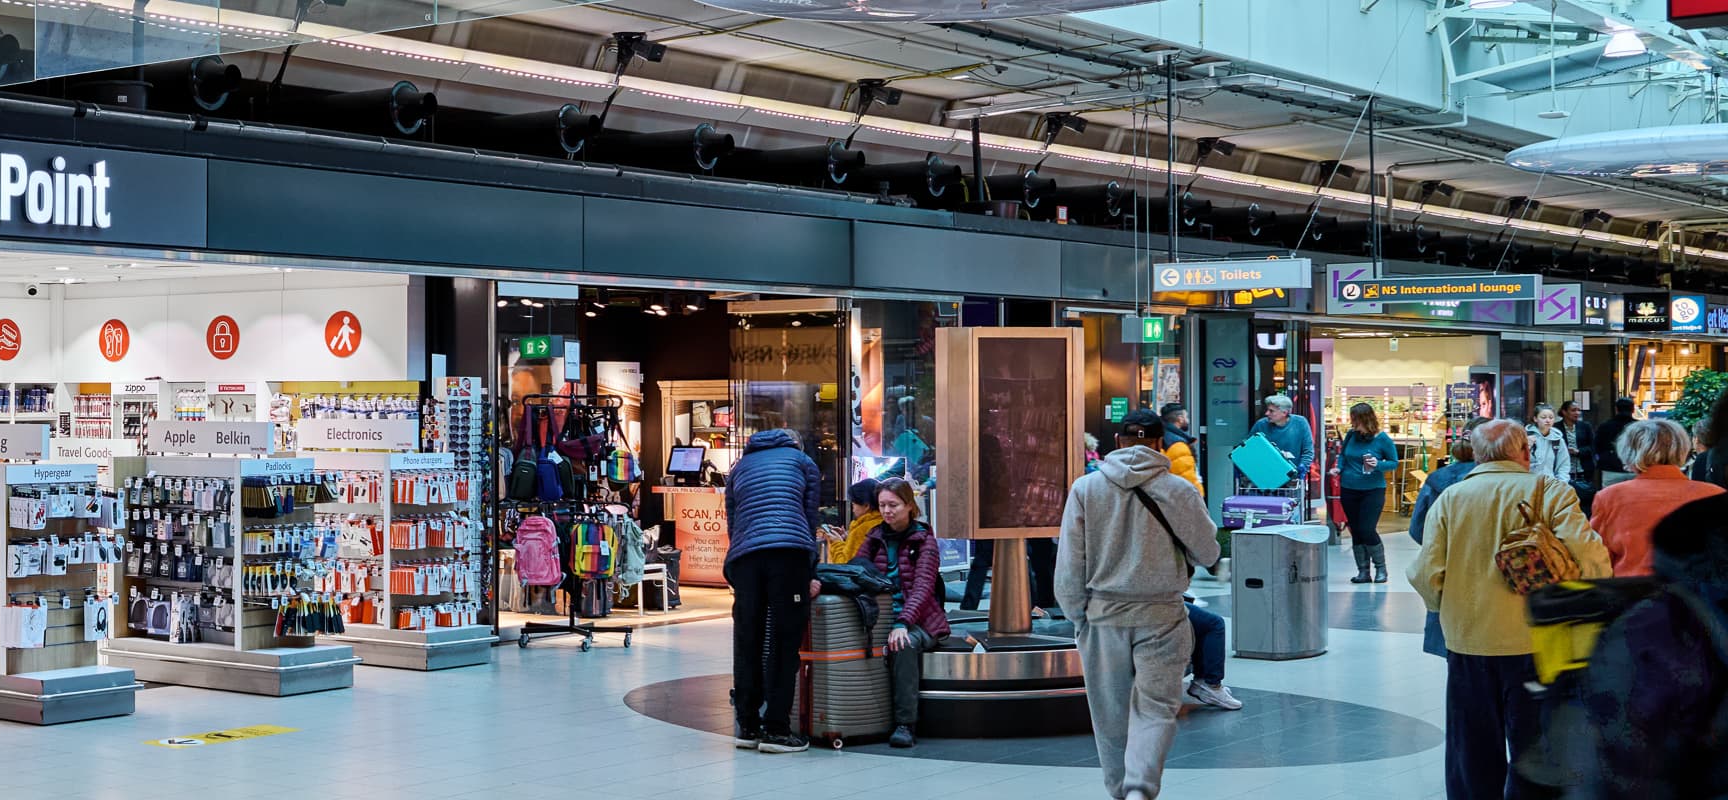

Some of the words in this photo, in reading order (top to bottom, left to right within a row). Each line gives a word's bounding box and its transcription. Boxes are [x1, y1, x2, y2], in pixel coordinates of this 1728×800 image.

[1220, 269, 1262, 281] Toilets
[1381, 285, 1398, 295] NS
[1400, 283, 1477, 294] International
[1479, 282, 1522, 295] lounge
[125, 384, 146, 393] zippo
[164, 430, 196, 446] Apple
[216, 431, 251, 445] Belkin
[327, 428, 383, 441] Electronics
[57, 446, 83, 458] Travel
[84, 447, 113, 458] Goods
[265, 463, 292, 471] Padlocks
[403, 457, 420, 465] Phone
[421, 457, 443, 467] chargers
[34, 468, 72, 480] Hypergear
[681, 508, 712, 520] SCAN,
[693, 521, 701, 531] &
[703, 521, 721, 531] GO
[694, 537, 707, 545] You
[713, 544, 727, 552] her
